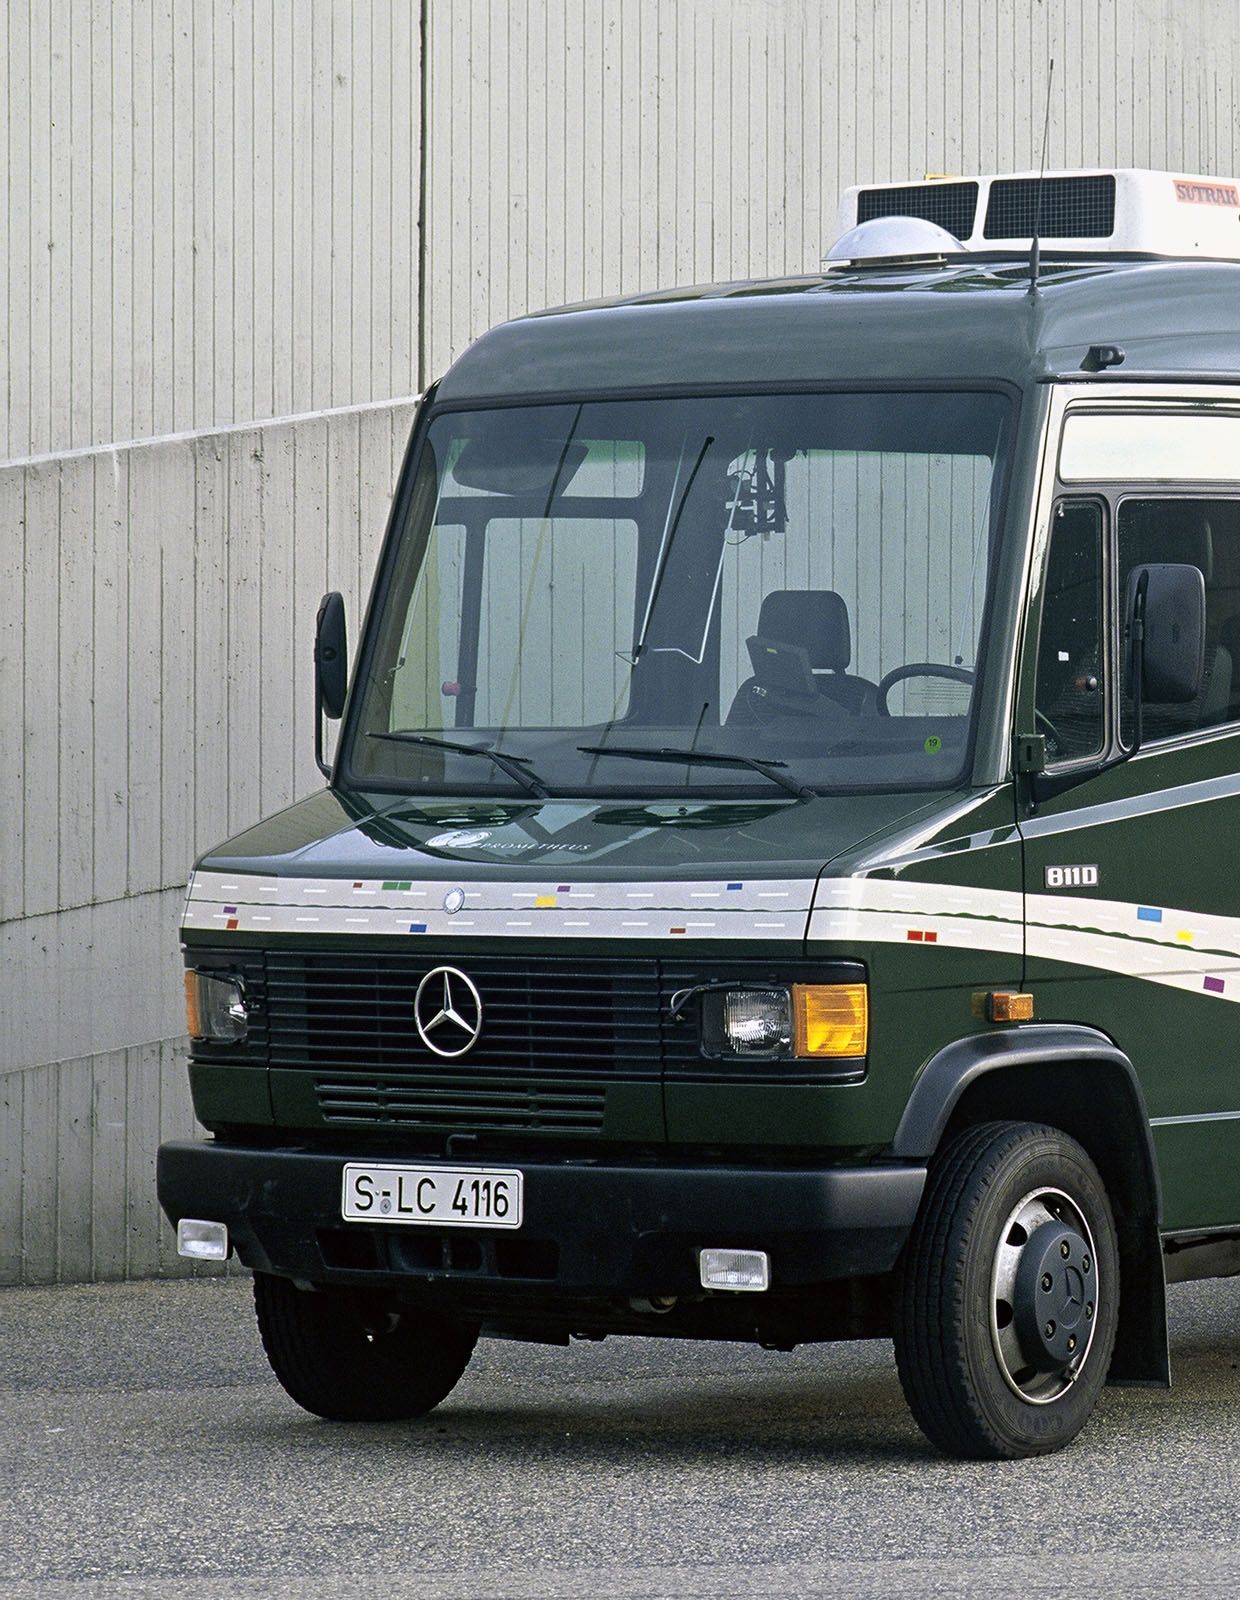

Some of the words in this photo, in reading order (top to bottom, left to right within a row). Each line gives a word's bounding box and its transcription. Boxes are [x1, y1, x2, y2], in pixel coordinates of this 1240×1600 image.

[1175, 184, 1239, 206] SUTRAK
[480, 842, 592, 850] PROMETHEUS
[452, 1179, 509, 1218] 4116
